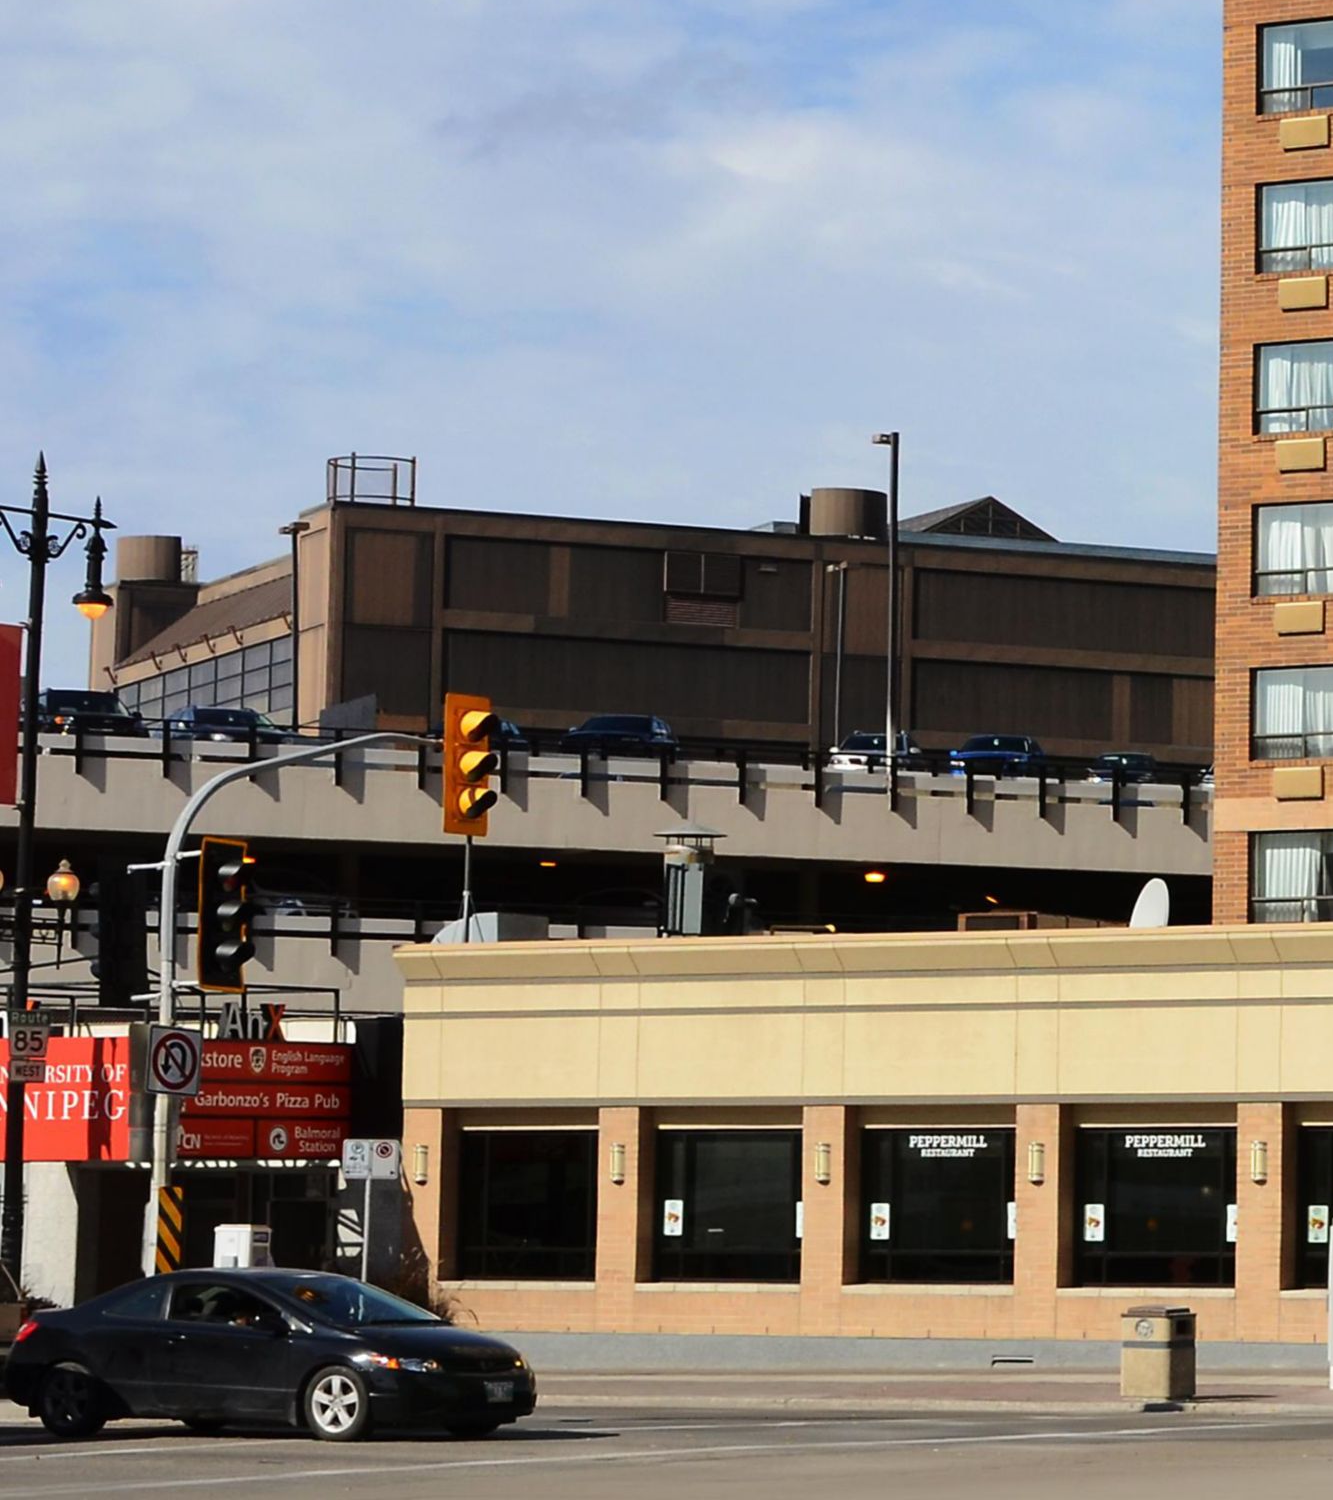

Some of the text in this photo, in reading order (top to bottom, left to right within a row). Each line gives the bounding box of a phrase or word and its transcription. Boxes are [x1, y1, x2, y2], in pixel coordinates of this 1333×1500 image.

[11, 1011, 49, 1023] Route
[14, 1030, 43, 1052] 85
[271, 1050, 345, 1066] English Language
[14, 1065, 41, 1077] WEST
[101, 1063, 127, 1083] OF
[271, 1064, 308, 1076] Program
[195, 1091, 340, 1109] Garbonzo's Pizza Pub
[294, 1126, 341, 1140] Balmoral
[298, 1139, 337, 1153] Station
[909, 1135, 987, 1148] PEPPERMILL
[1125, 1135, 1206, 1148] PEPPERMILL
[920, 1149, 976, 1158] RESTAURANT
[1137, 1149, 1193, 1158] RESTAURANT
